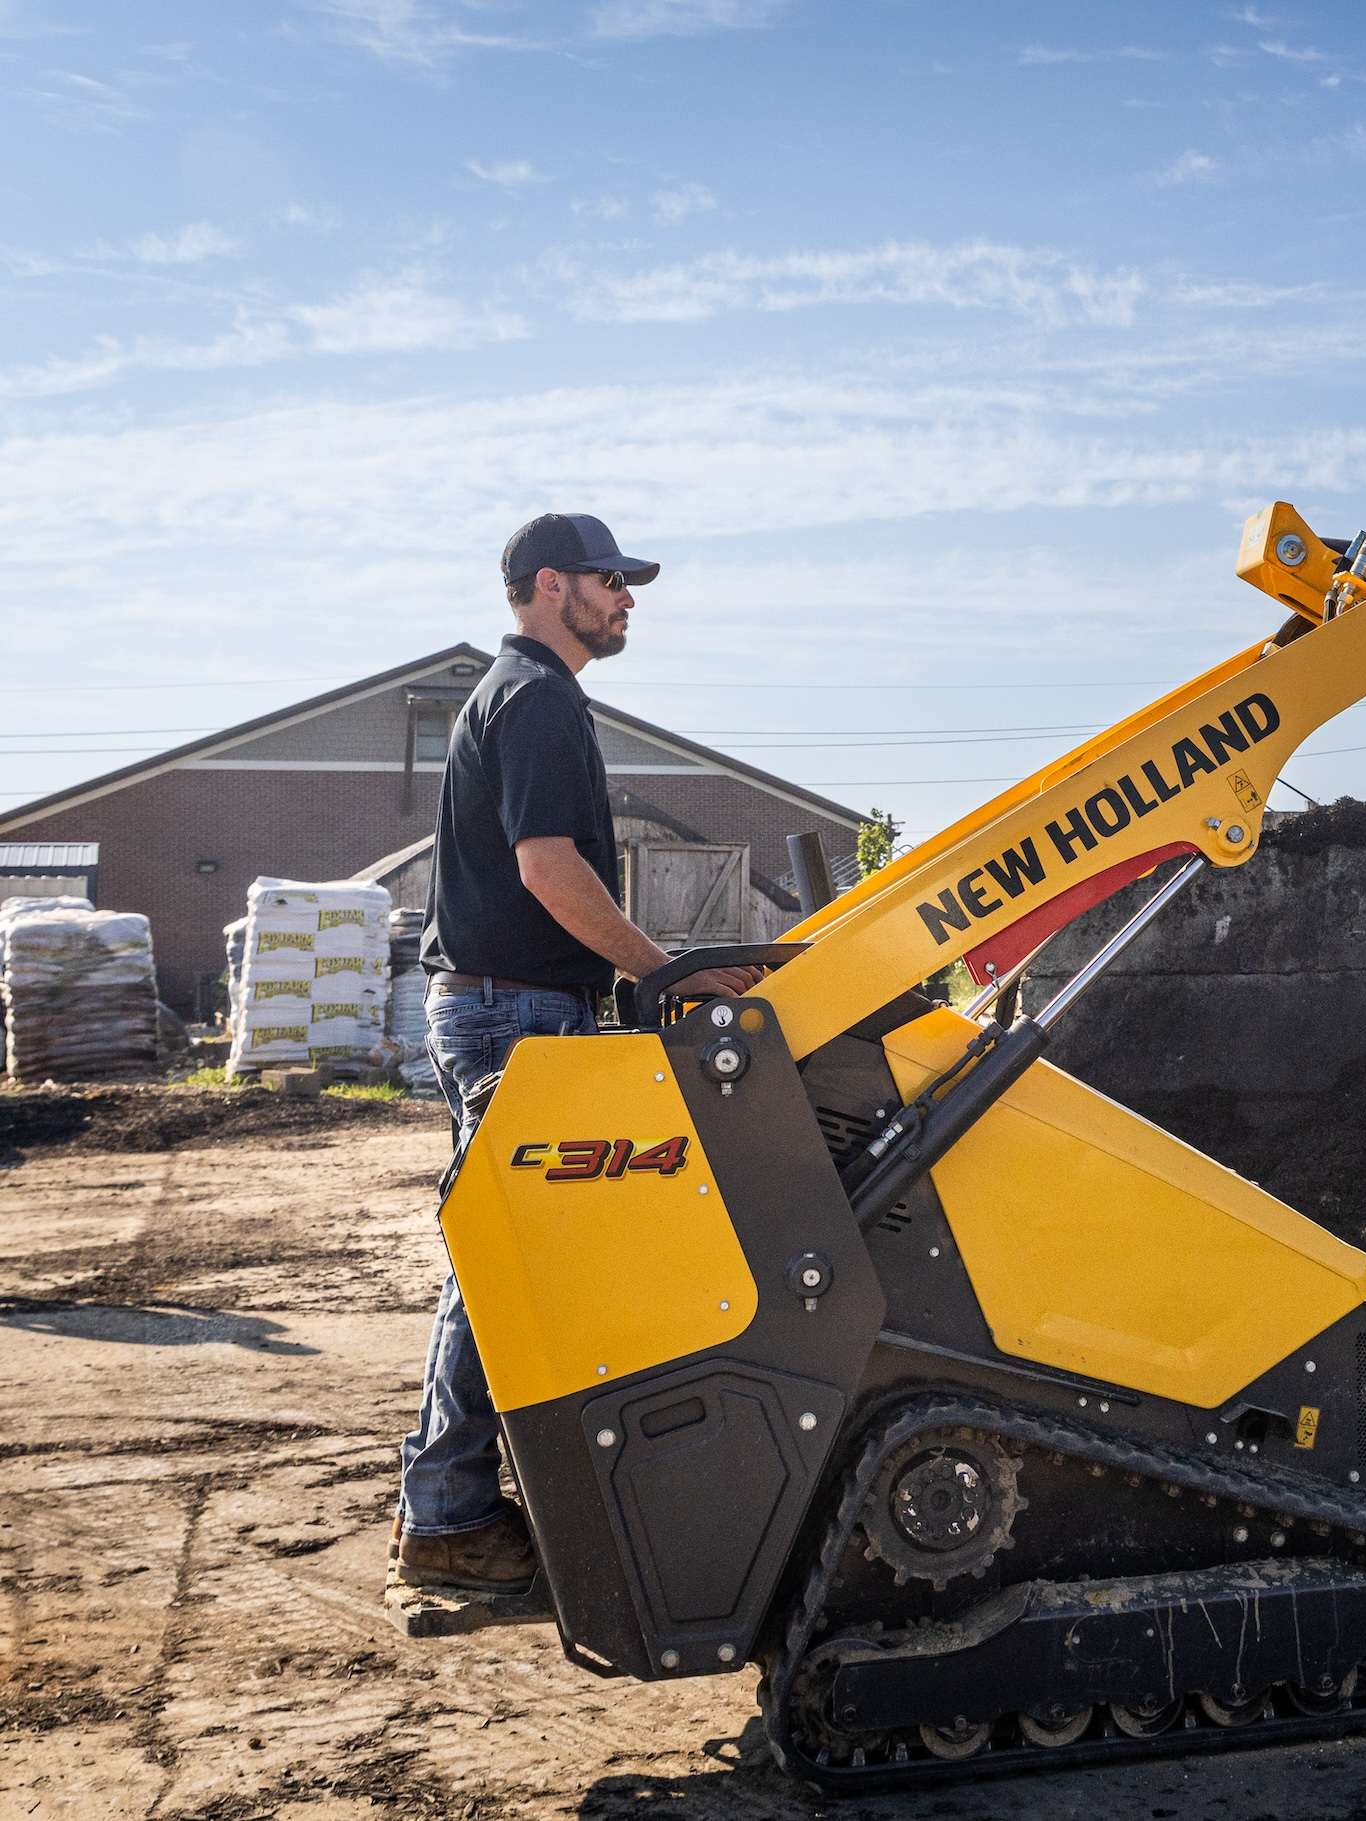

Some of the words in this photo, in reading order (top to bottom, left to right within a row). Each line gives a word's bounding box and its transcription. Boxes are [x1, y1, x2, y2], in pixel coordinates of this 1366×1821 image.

[915, 836, 1047, 946] NEW
[1044, 692, 1281, 865] HOLLAND
[510, 1136, 690, 1181] C314
